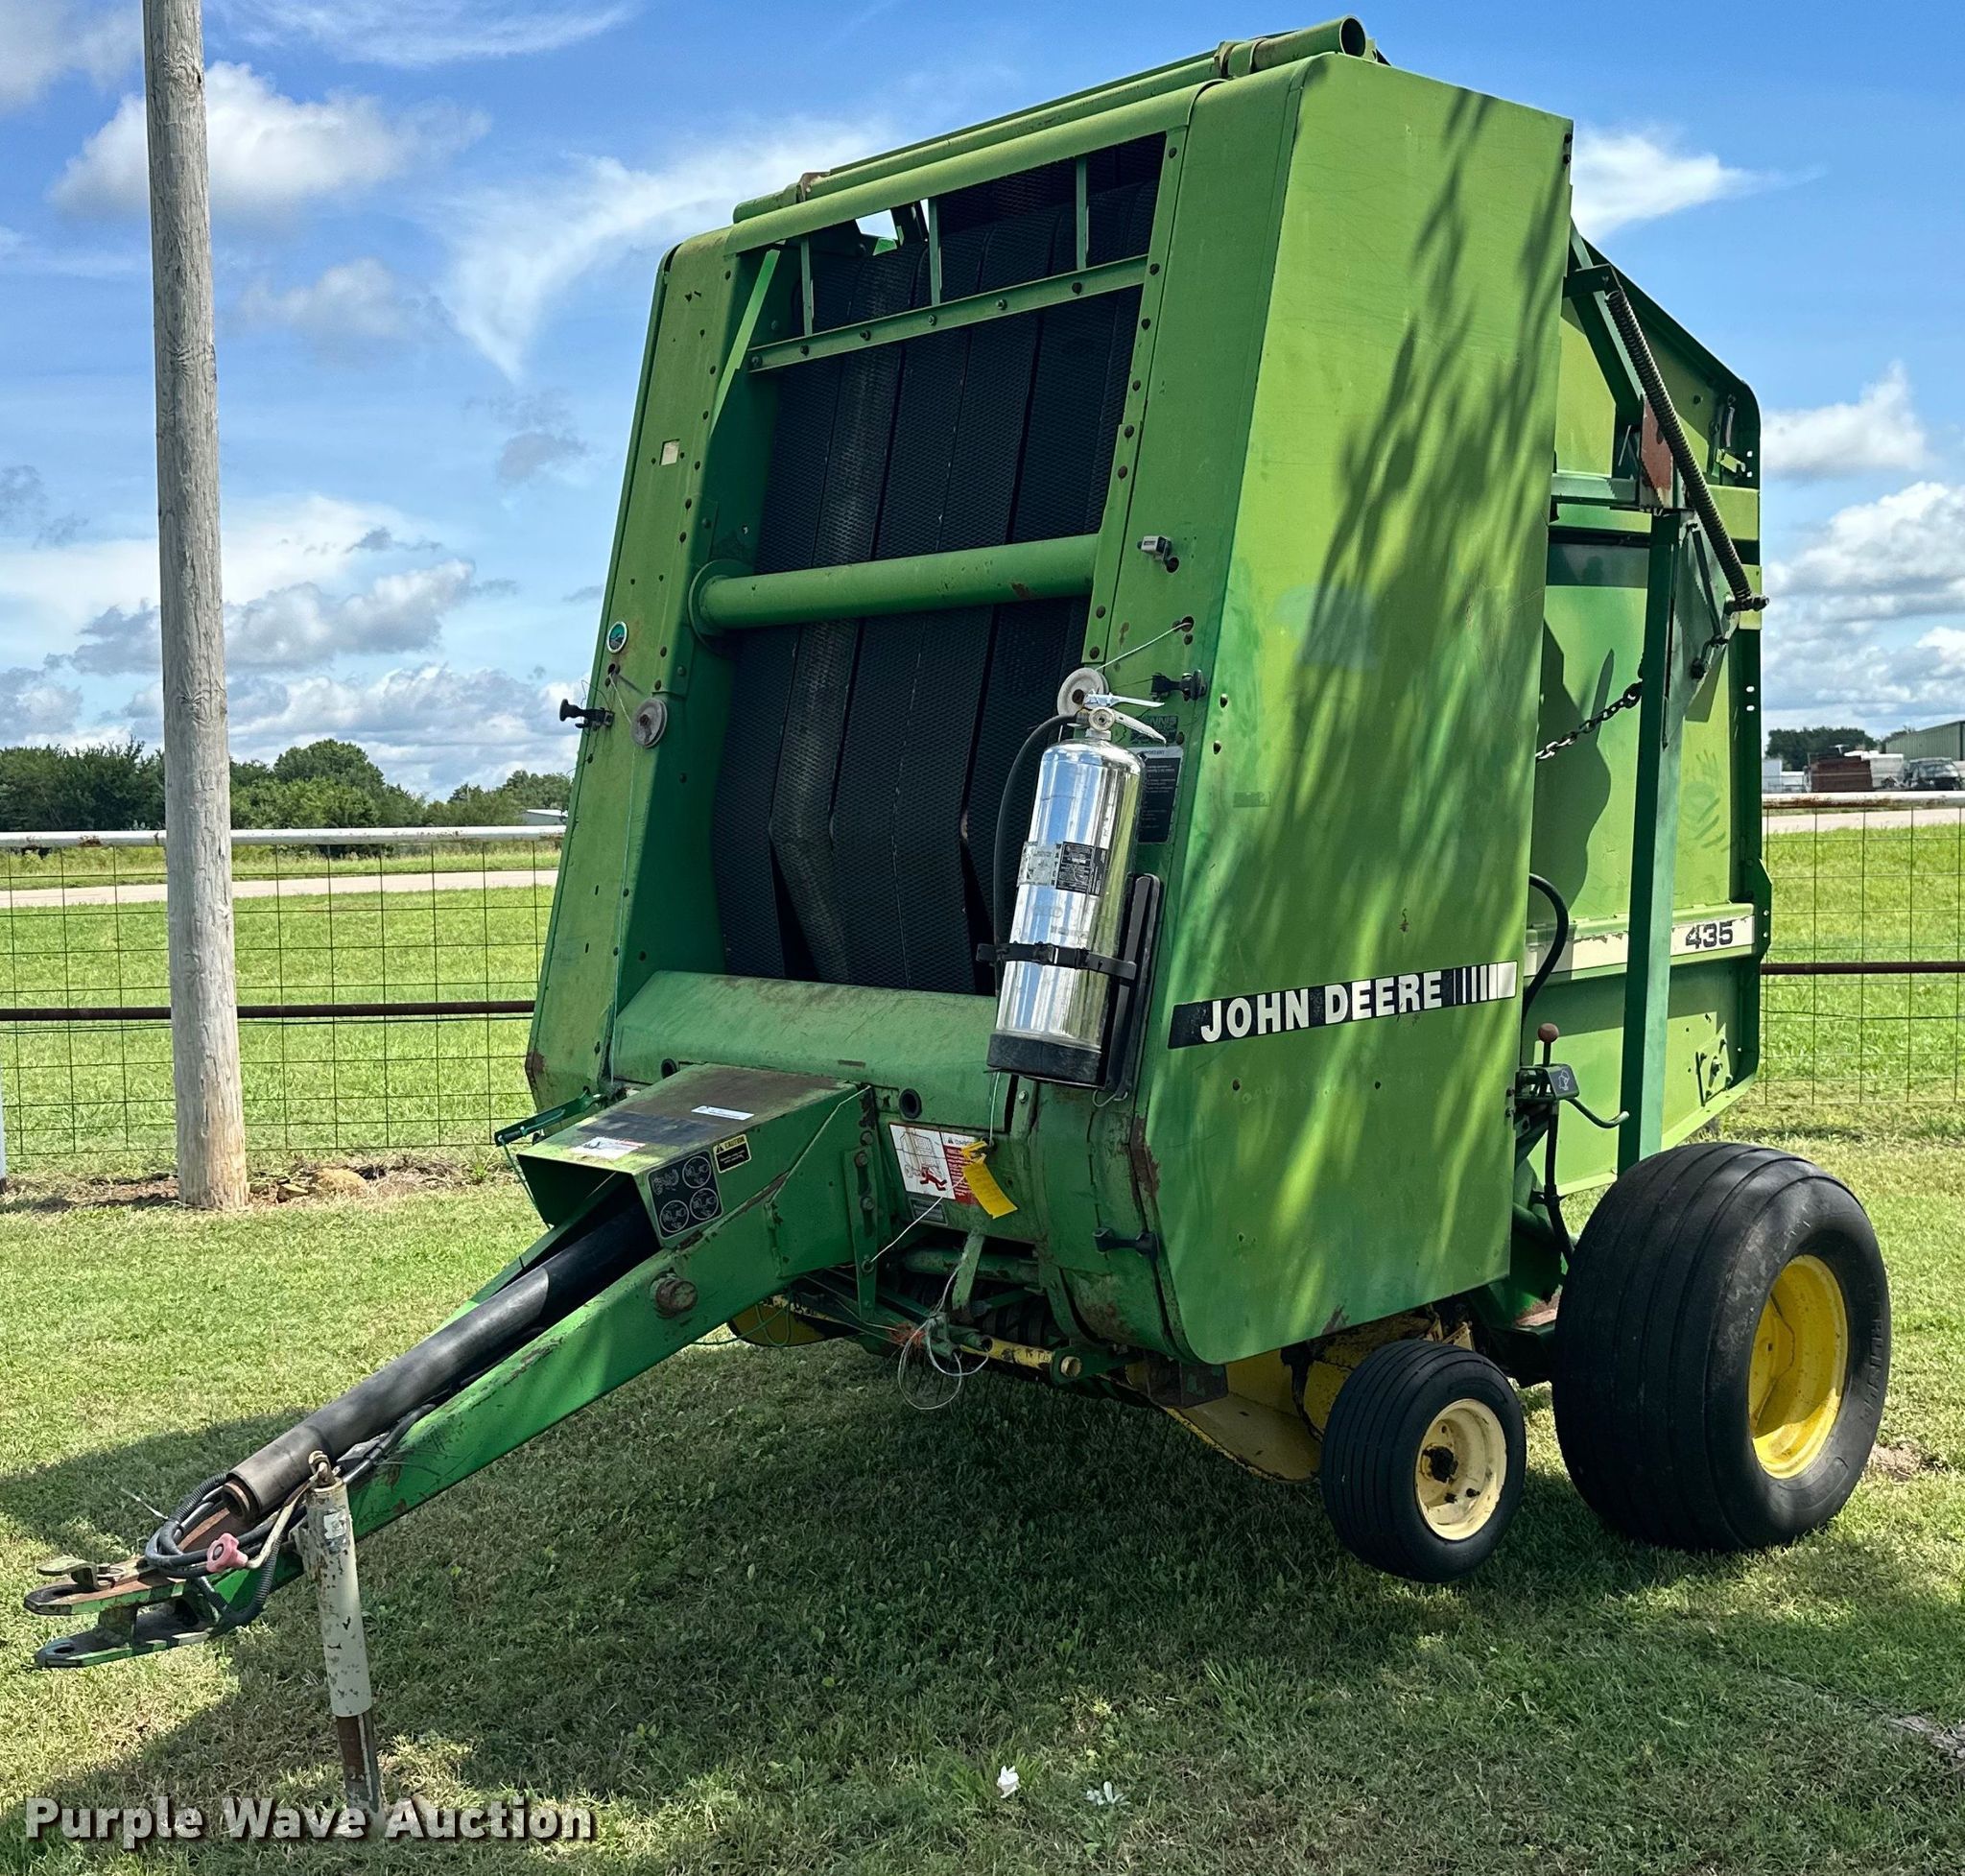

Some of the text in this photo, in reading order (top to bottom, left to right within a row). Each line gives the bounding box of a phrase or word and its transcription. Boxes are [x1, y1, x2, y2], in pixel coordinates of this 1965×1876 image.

[1686, 921, 1734, 949] 435
[1200, 970, 1442, 1042] JOHN DEERE
